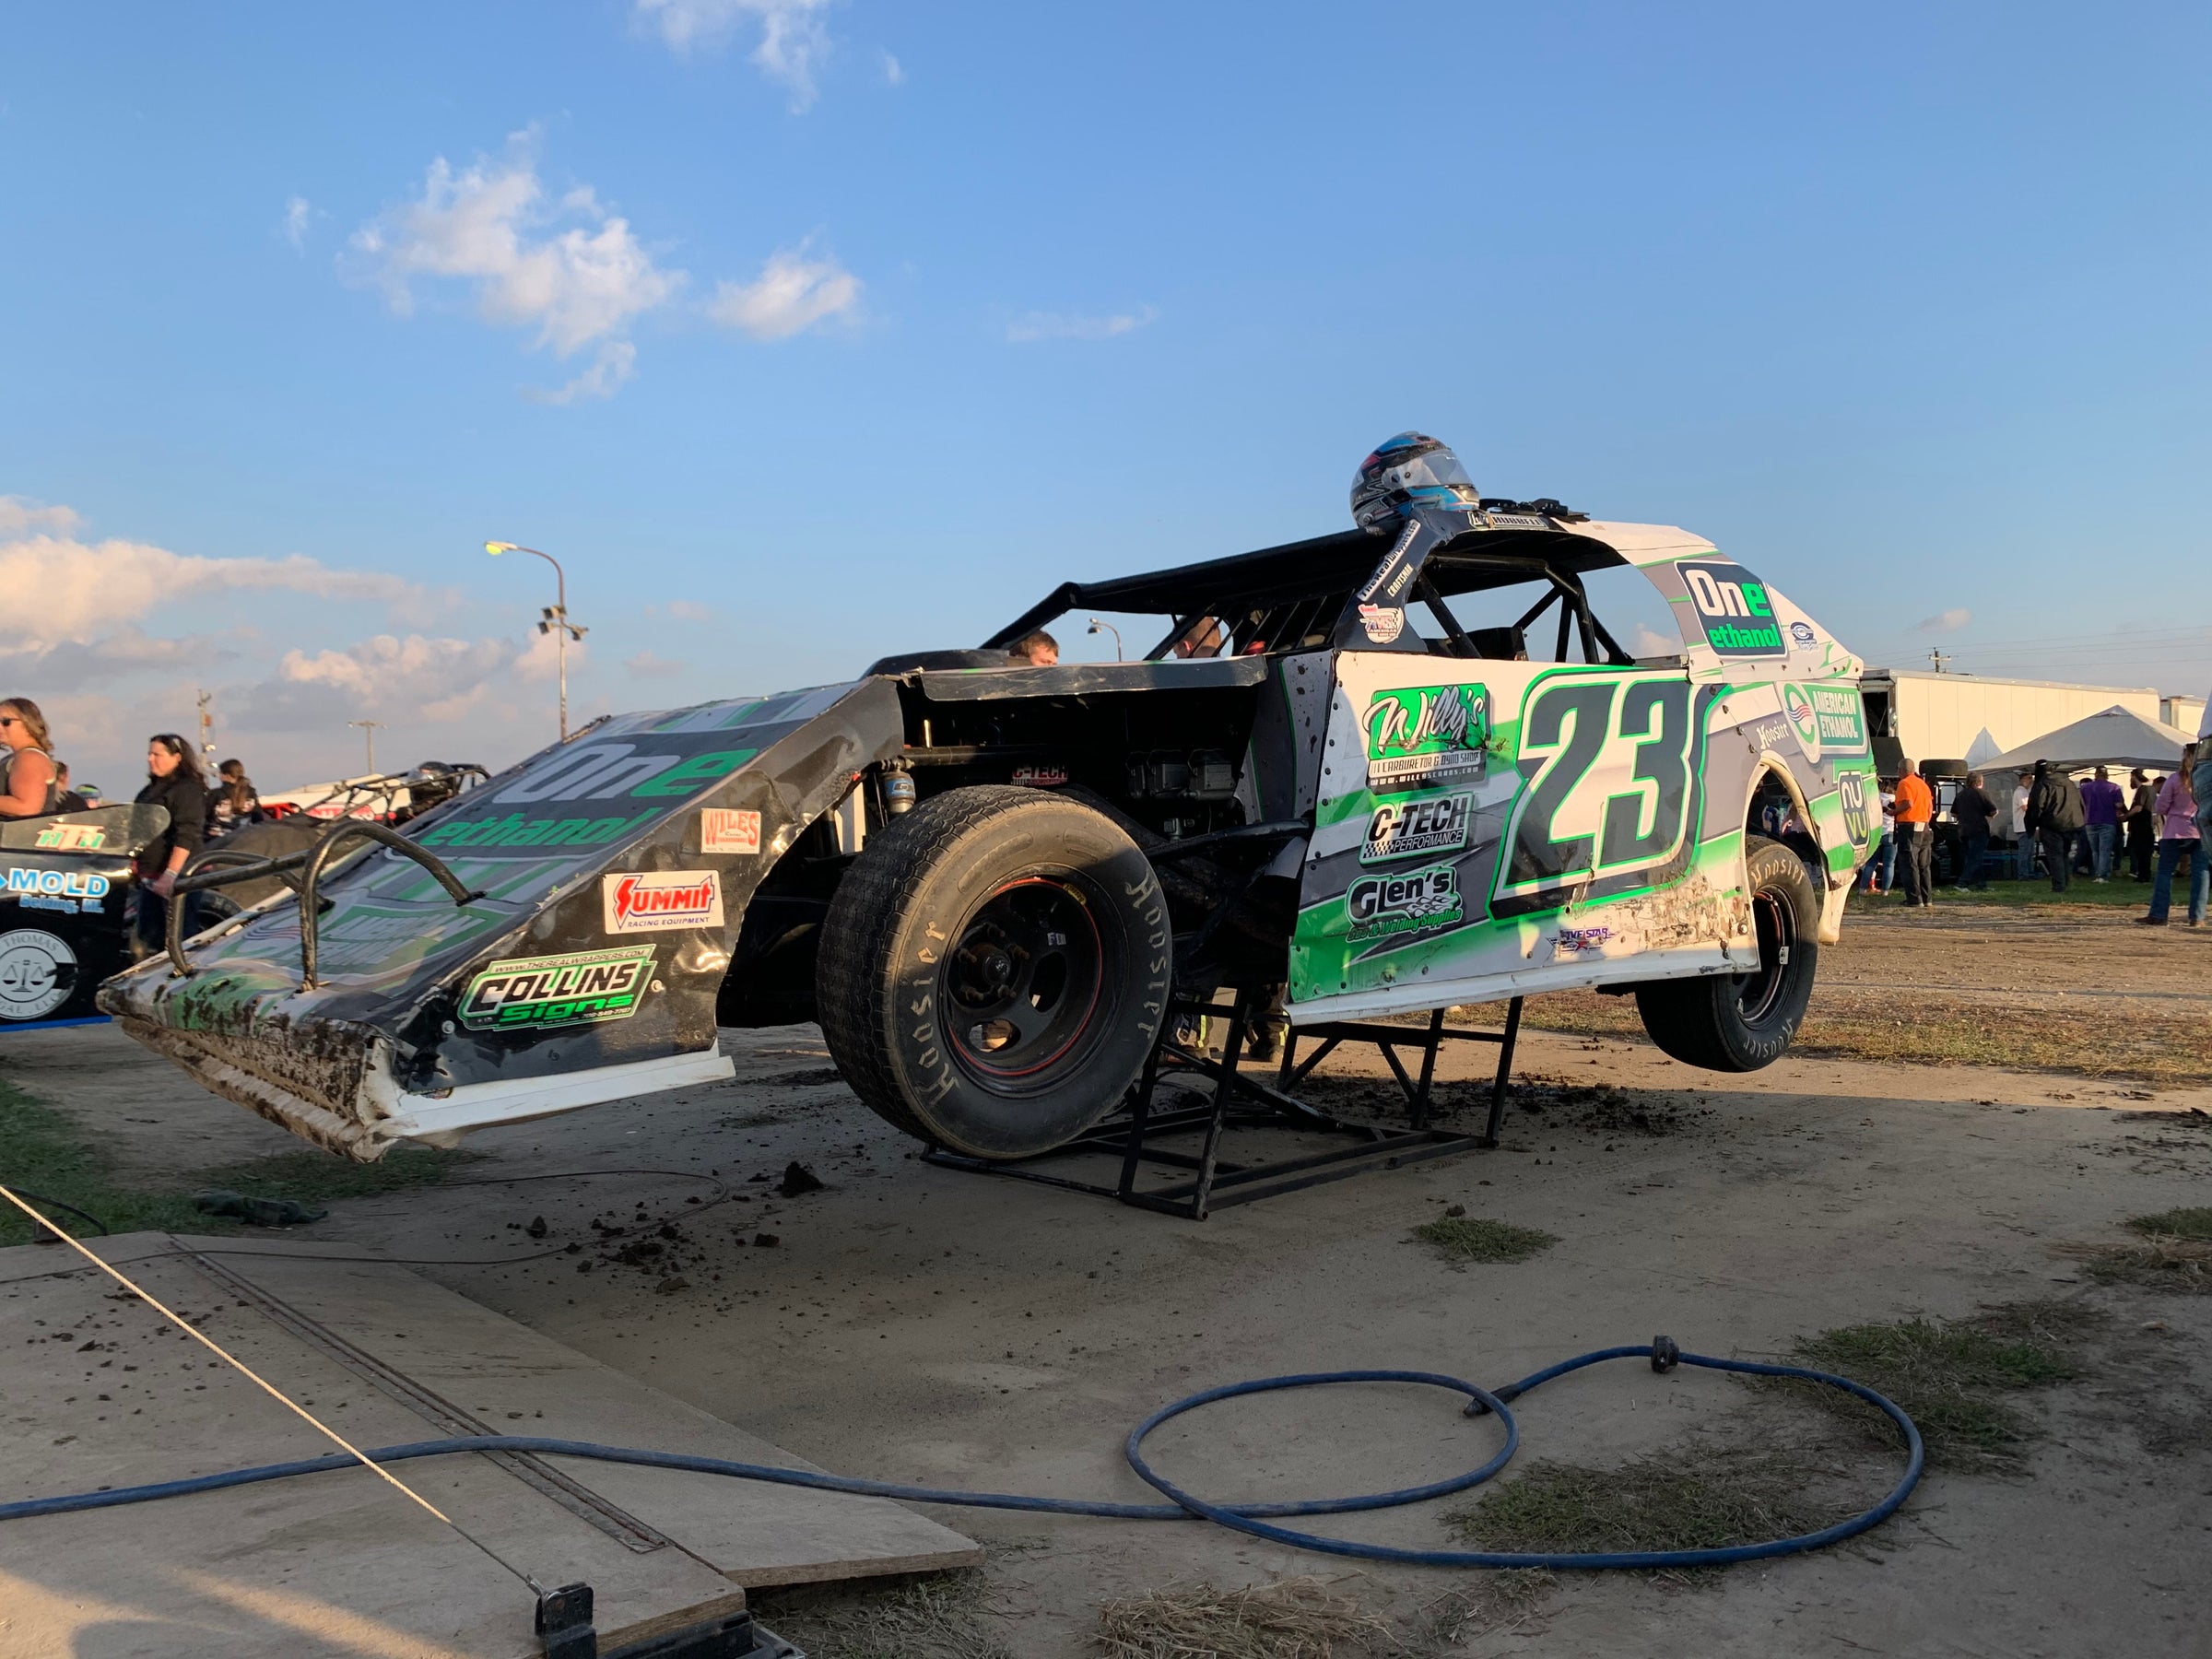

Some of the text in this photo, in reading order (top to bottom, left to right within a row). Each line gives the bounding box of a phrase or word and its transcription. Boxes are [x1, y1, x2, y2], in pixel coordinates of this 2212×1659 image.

[1686, 570, 1771, 617] One
[1709, 624, 1782, 647] ethanol
[1812, 690, 1856, 714] AMERICAN
[1362, 686, 1484, 755] Willy's
[1757, 720, 1789, 749] Hoosier
[1818, 714, 1858, 738] ETHANOL
[491, 744, 758, 804] One
[1382, 758, 1432, 773] CARBURETOR
[1503, 679, 1694, 888] 23
[418, 807, 664, 846] ethanol
[703, 811, 759, 846] WILES
[1369, 797, 1468, 841] C-TECH
[1393, 830, 1463, 852] PERFORMANCE
[7, 868, 110, 898] MOLD
[1349, 871, 1450, 920] Glen's
[627, 917, 711, 928] RACING EQUIPMENT
[1381, 916, 1420, 935] Welding
[1420, 908, 1462, 928] Supplies
[3, 934, 59, 952] THOMAS
[467, 962, 639, 1013] COLLINS
